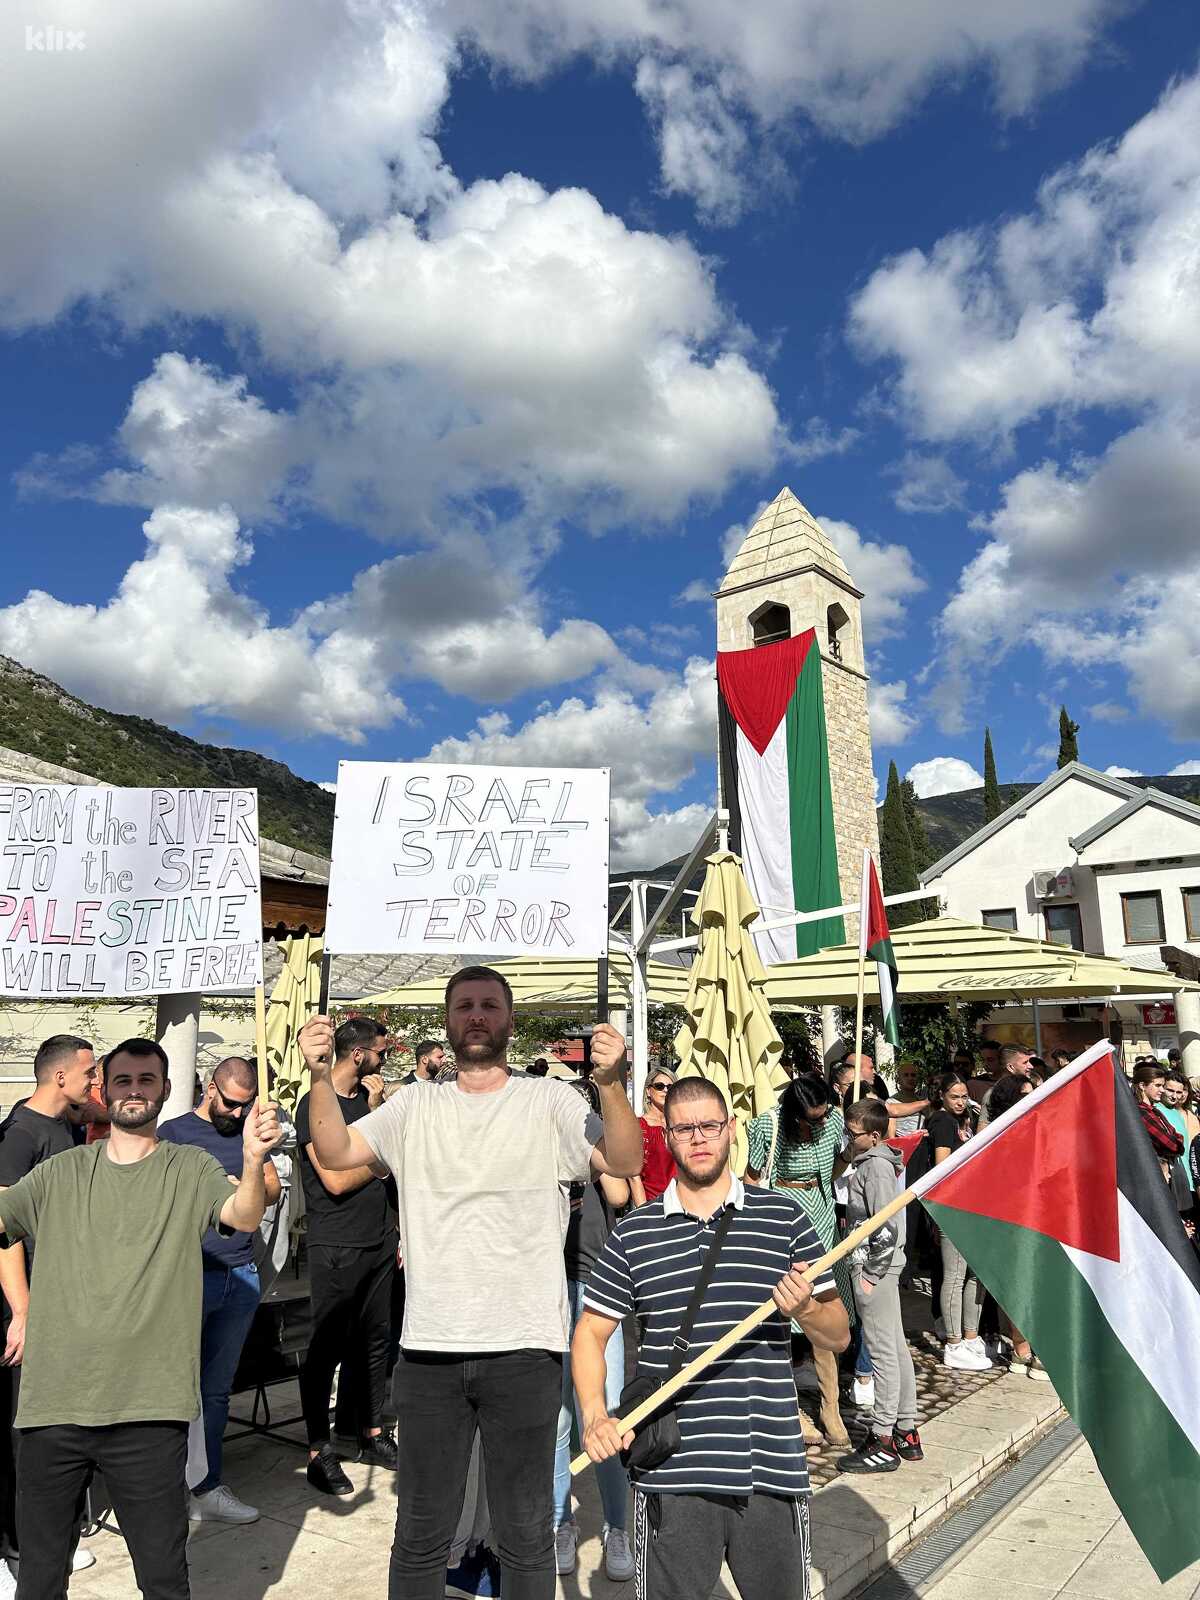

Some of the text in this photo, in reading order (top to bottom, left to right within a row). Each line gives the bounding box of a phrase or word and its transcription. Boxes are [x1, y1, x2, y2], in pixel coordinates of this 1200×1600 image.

[85, 791, 137, 846] the
[149, 789, 257, 845] RIVER
[372, 774, 589, 830] ISRAEL
[3, 844, 257, 894] TO the SEA
[393, 830, 570, 876] STATE
[453, 873, 499, 897] OF
[386, 898, 575, 947] TERROR
[2, 942, 259, 991] WILL BE FREE
